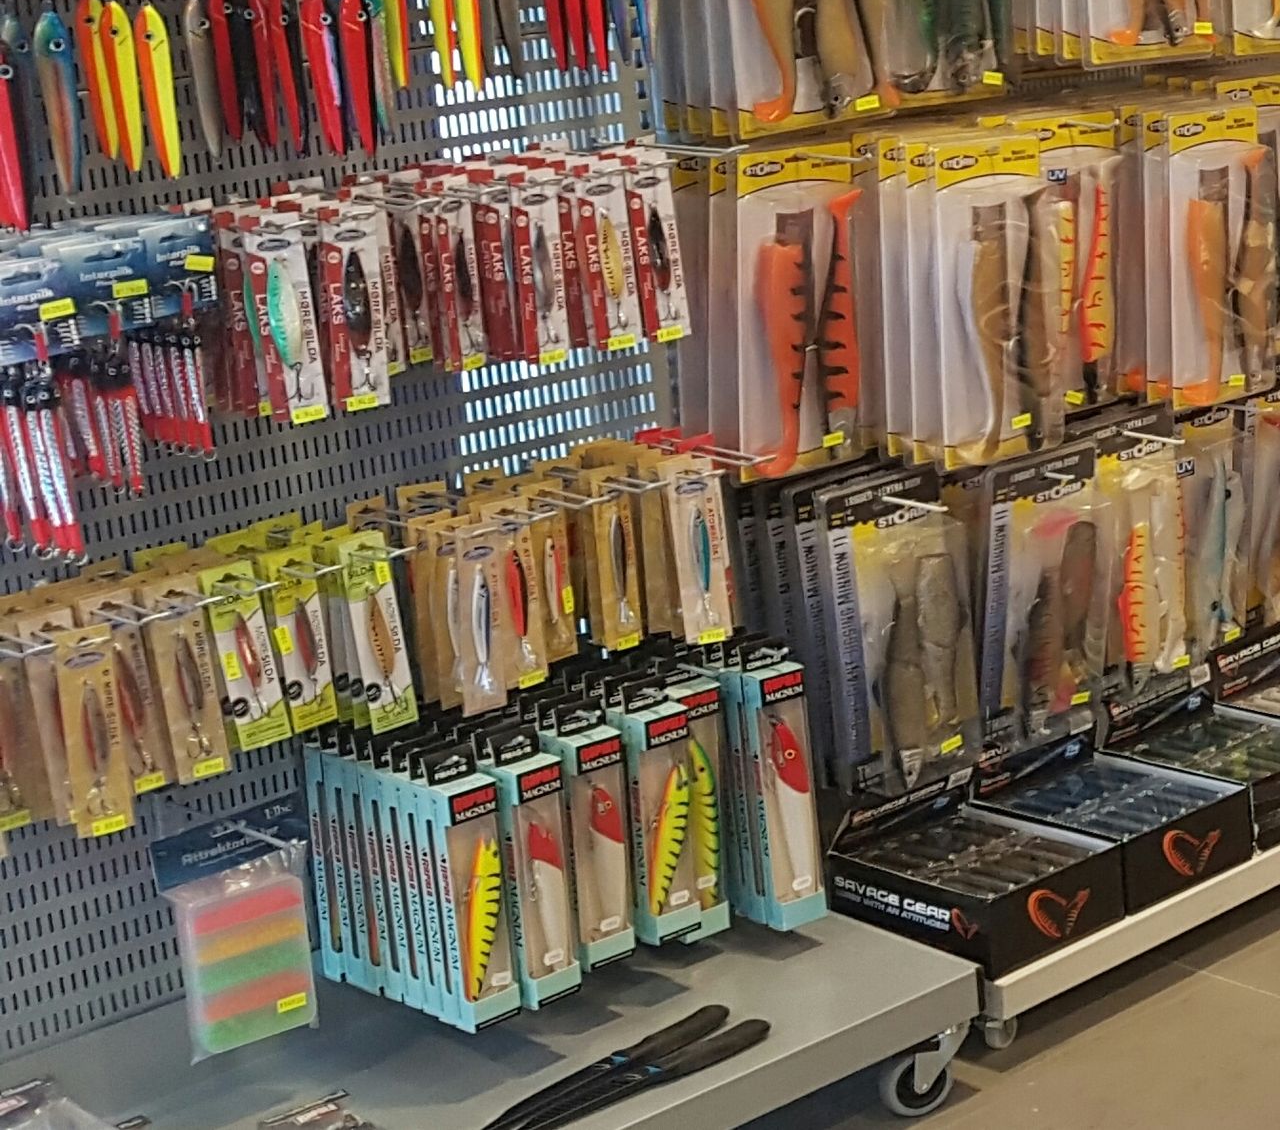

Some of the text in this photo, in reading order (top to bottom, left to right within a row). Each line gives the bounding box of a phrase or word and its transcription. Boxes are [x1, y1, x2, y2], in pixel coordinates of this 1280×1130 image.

[490, 241, 504, 282] LAKS
[562, 231, 577, 270] LAKS
[584, 234, 600, 274] LAKS
[634, 226, 650, 265] LAKS
[80, 266, 133, 283] Interpilk
[441, 252, 453, 293] LAKS
[519, 245, 533, 285] LAKS
[255, 294, 270, 336] LAKS
[329, 283, 344, 325] LAKS
[1193, 407, 1231, 427] STORM
[1119, 440, 1162, 461] STORM
[1036, 481, 1082, 503] STORM
[834, 550, 855, 604] MINNOW
[1219, 642, 1262, 667] SAVAGE
[765, 685, 804, 704] MAGNUM
[650, 727, 689, 747] MAGNUM
[581, 752, 622, 772] MAGNUM
[522, 779, 561, 801] MAGNUM
[455, 801, 497, 823] MAGNUM
[834, 876, 950, 922] SAVAGE GEAR
